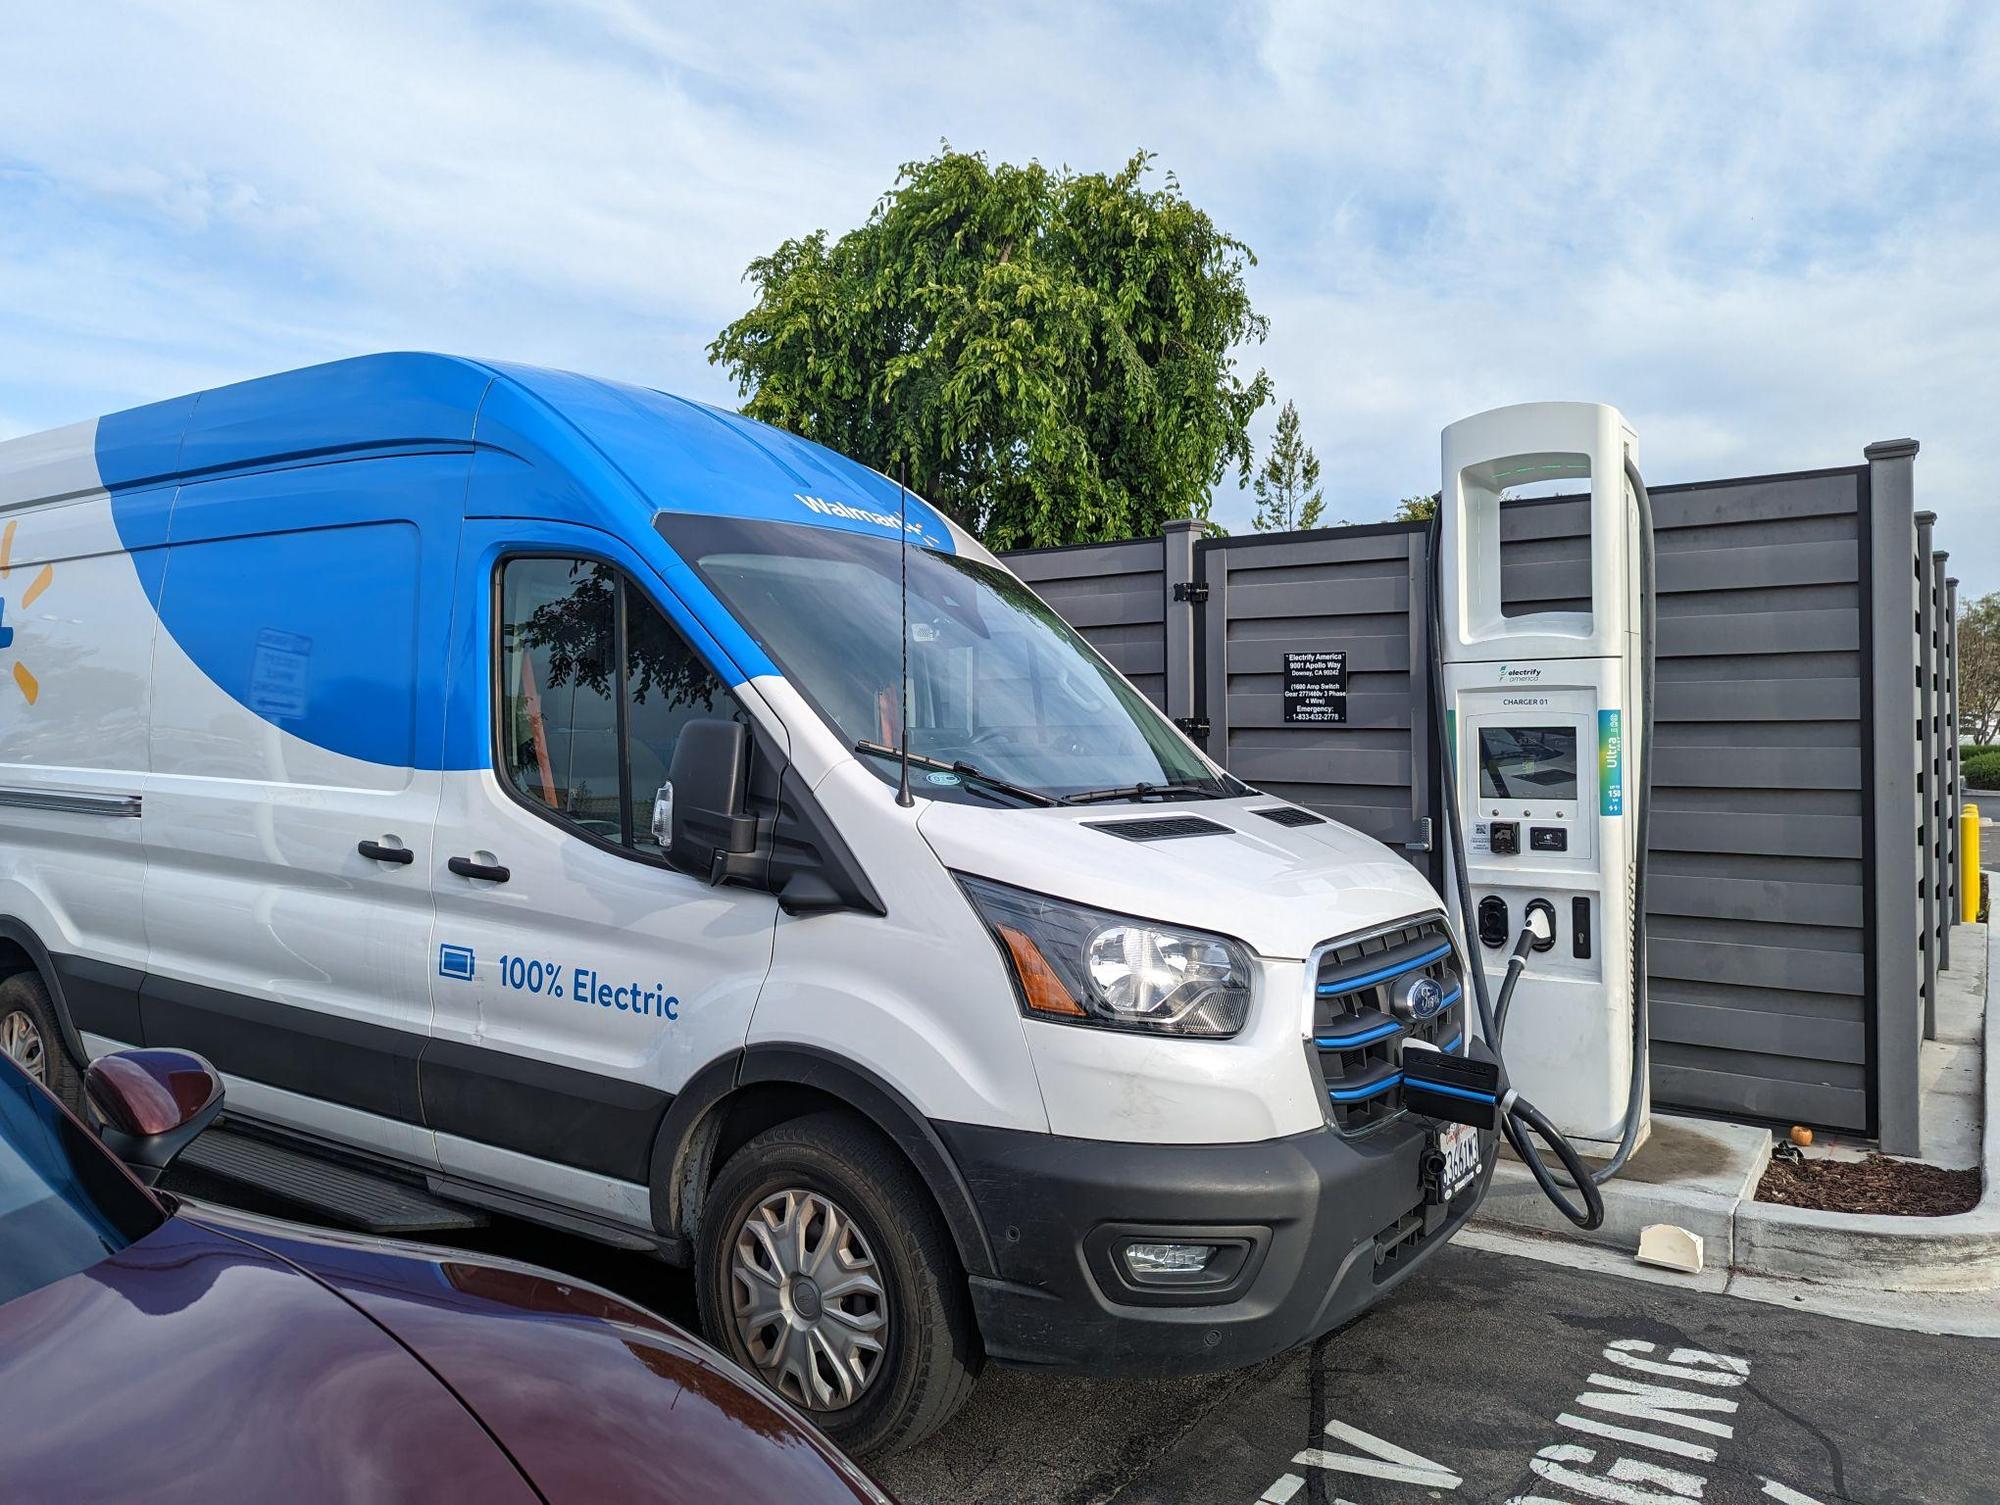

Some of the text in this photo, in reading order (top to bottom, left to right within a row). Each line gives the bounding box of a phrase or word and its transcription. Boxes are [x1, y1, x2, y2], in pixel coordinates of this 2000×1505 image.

[793, 494, 907, 531] Walmart
[1327, 661, 1341, 669] Way
[1296, 705, 1334, 713] Emergency:
[1605, 737, 1617, 768] Ultra
[499, 955, 680, 1021] 100% Electric
